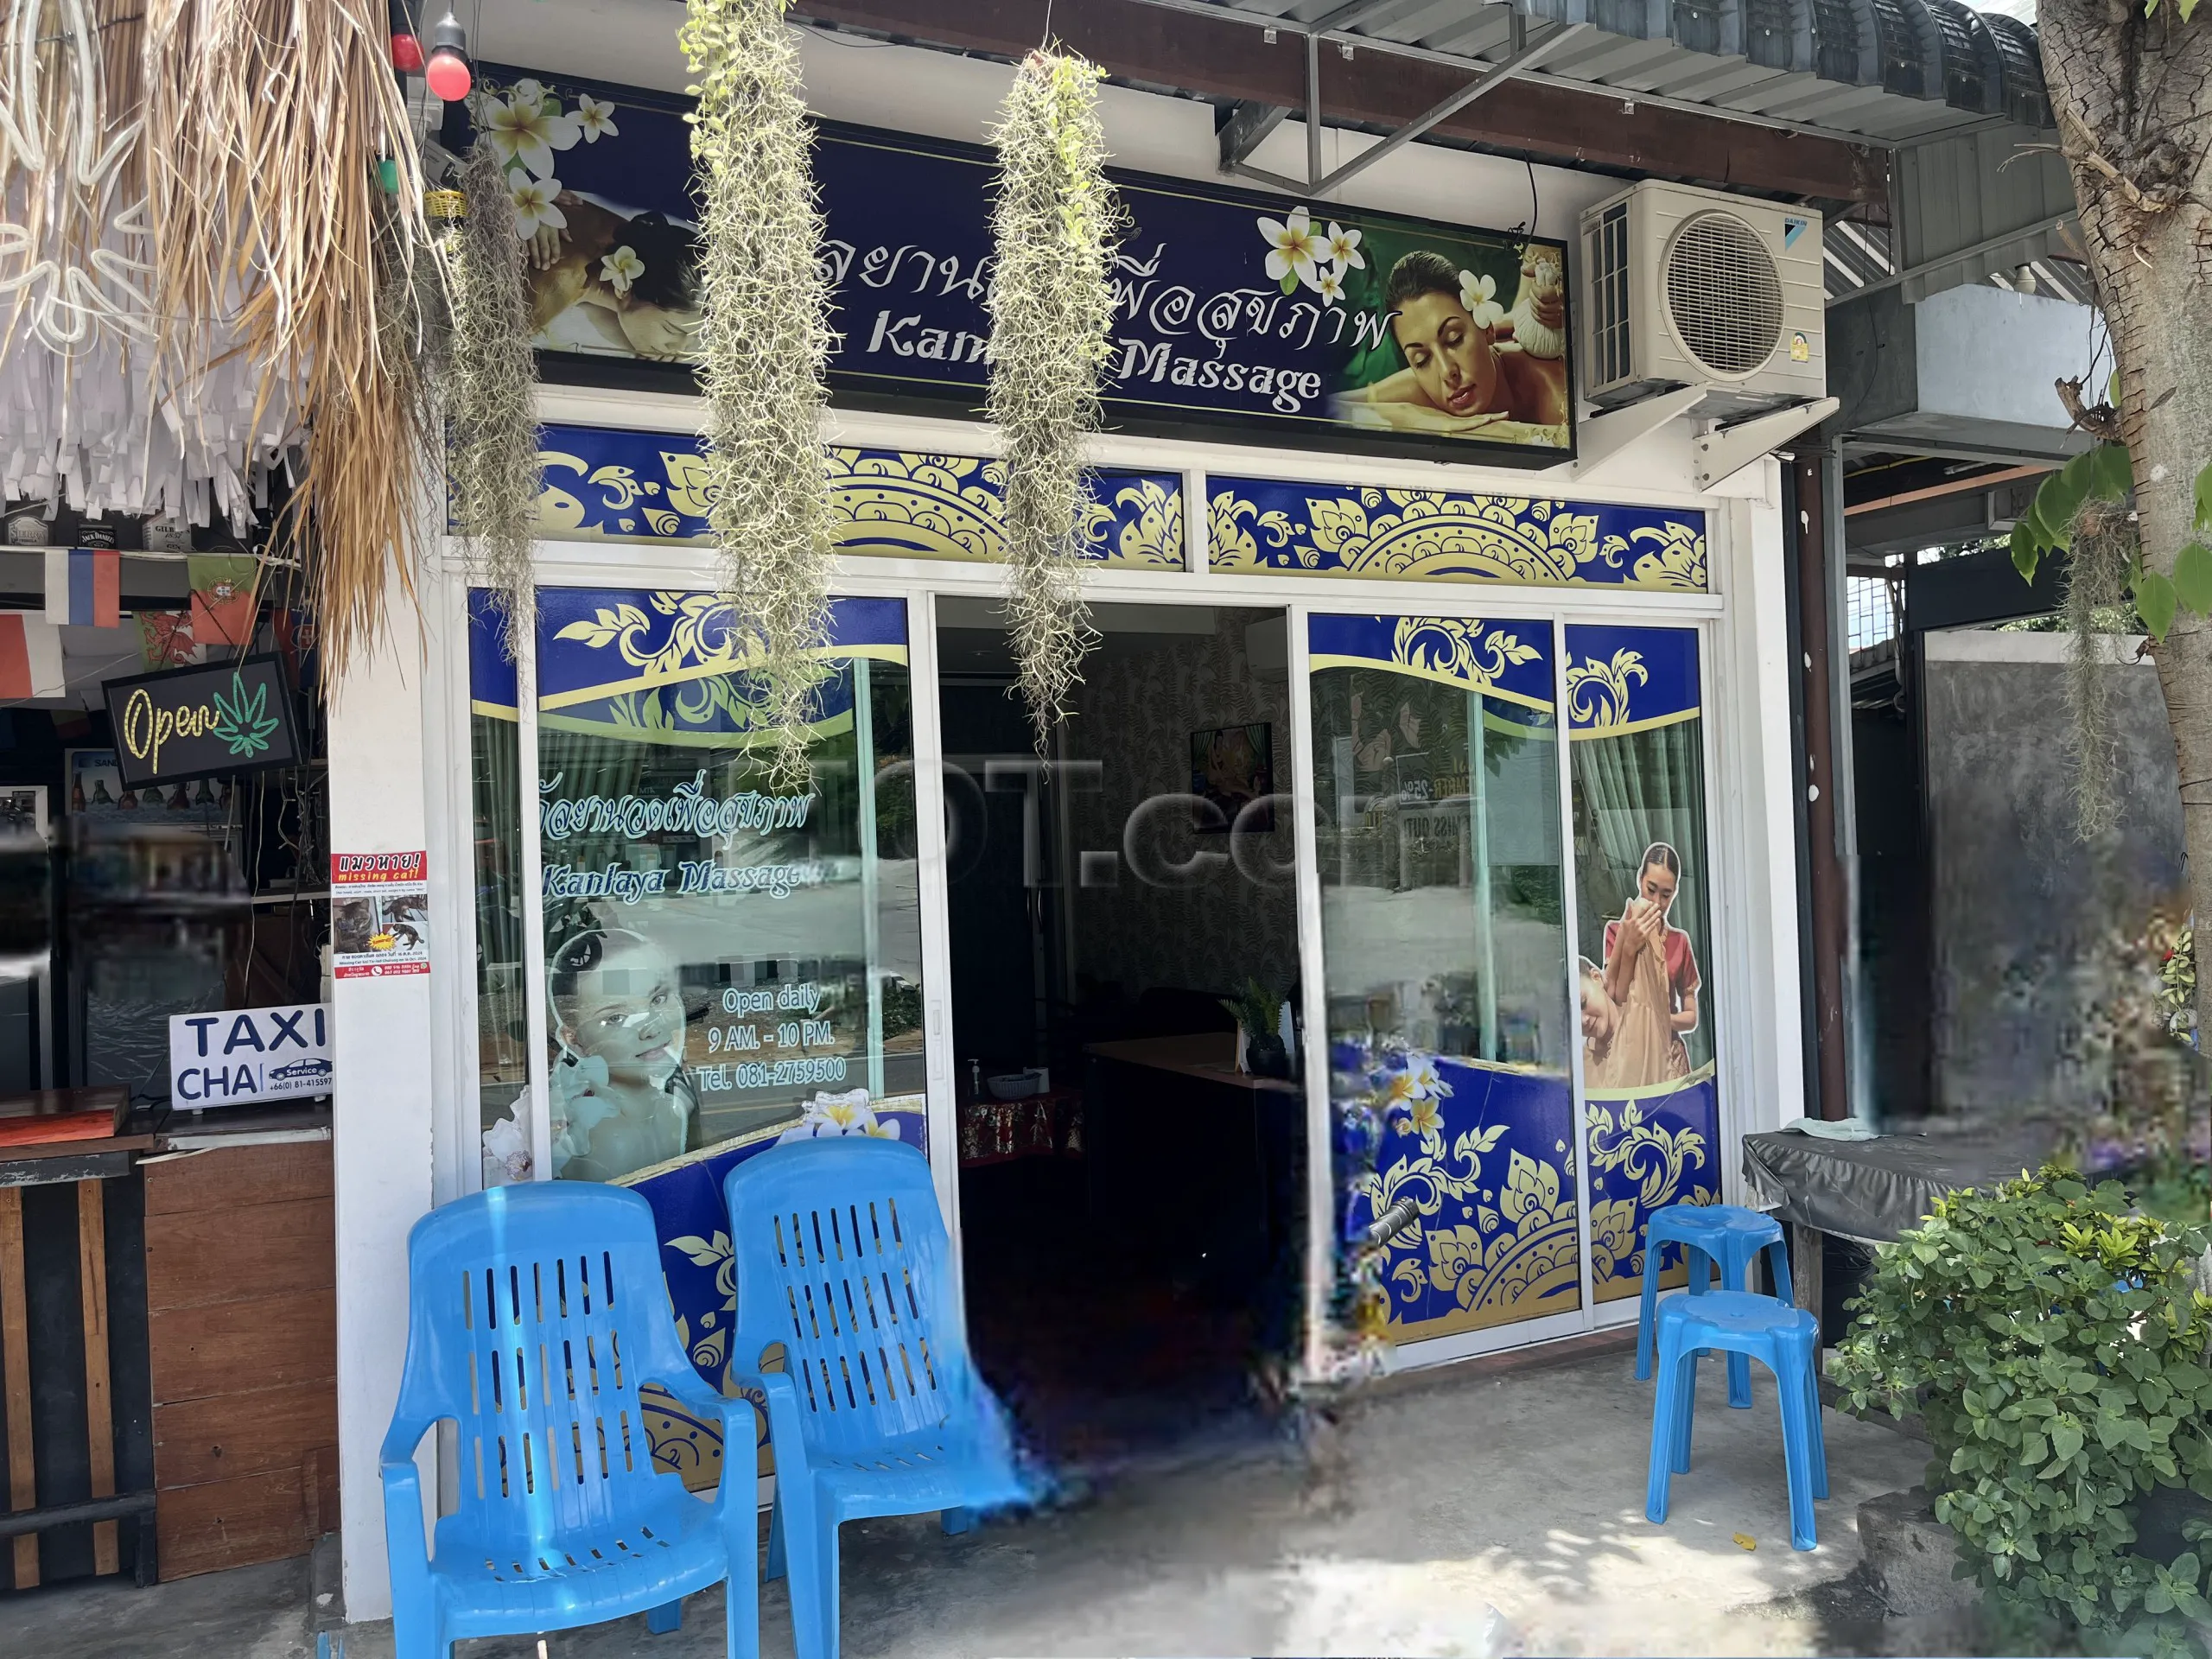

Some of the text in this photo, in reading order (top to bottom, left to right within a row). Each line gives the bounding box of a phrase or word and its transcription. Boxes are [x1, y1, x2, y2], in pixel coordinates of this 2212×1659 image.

[1118, 337, 1322, 414] Massage
[81, 533, 95, 543] JACK
[124, 689, 220, 774] Open
[338, 868, 419, 881] missing cat!
[340, 853, 421, 871] แมวหาย!
[542, 860, 801, 906] Kanlaya Massage
[722, 983, 821, 1019] Open daily
[185, 1007, 326, 1057] TAXI
[708, 1027, 721, 1053] 9
[723, 1025, 760, 1052] AM.
[778, 1022, 800, 1048] 10
[803, 1020, 836, 1047] PM.
[270, 1082, 292, 1091] +66(0)
[286, 1067, 318, 1077] Service
[696, 1056, 847, 1092] Tel. 081-2759500
